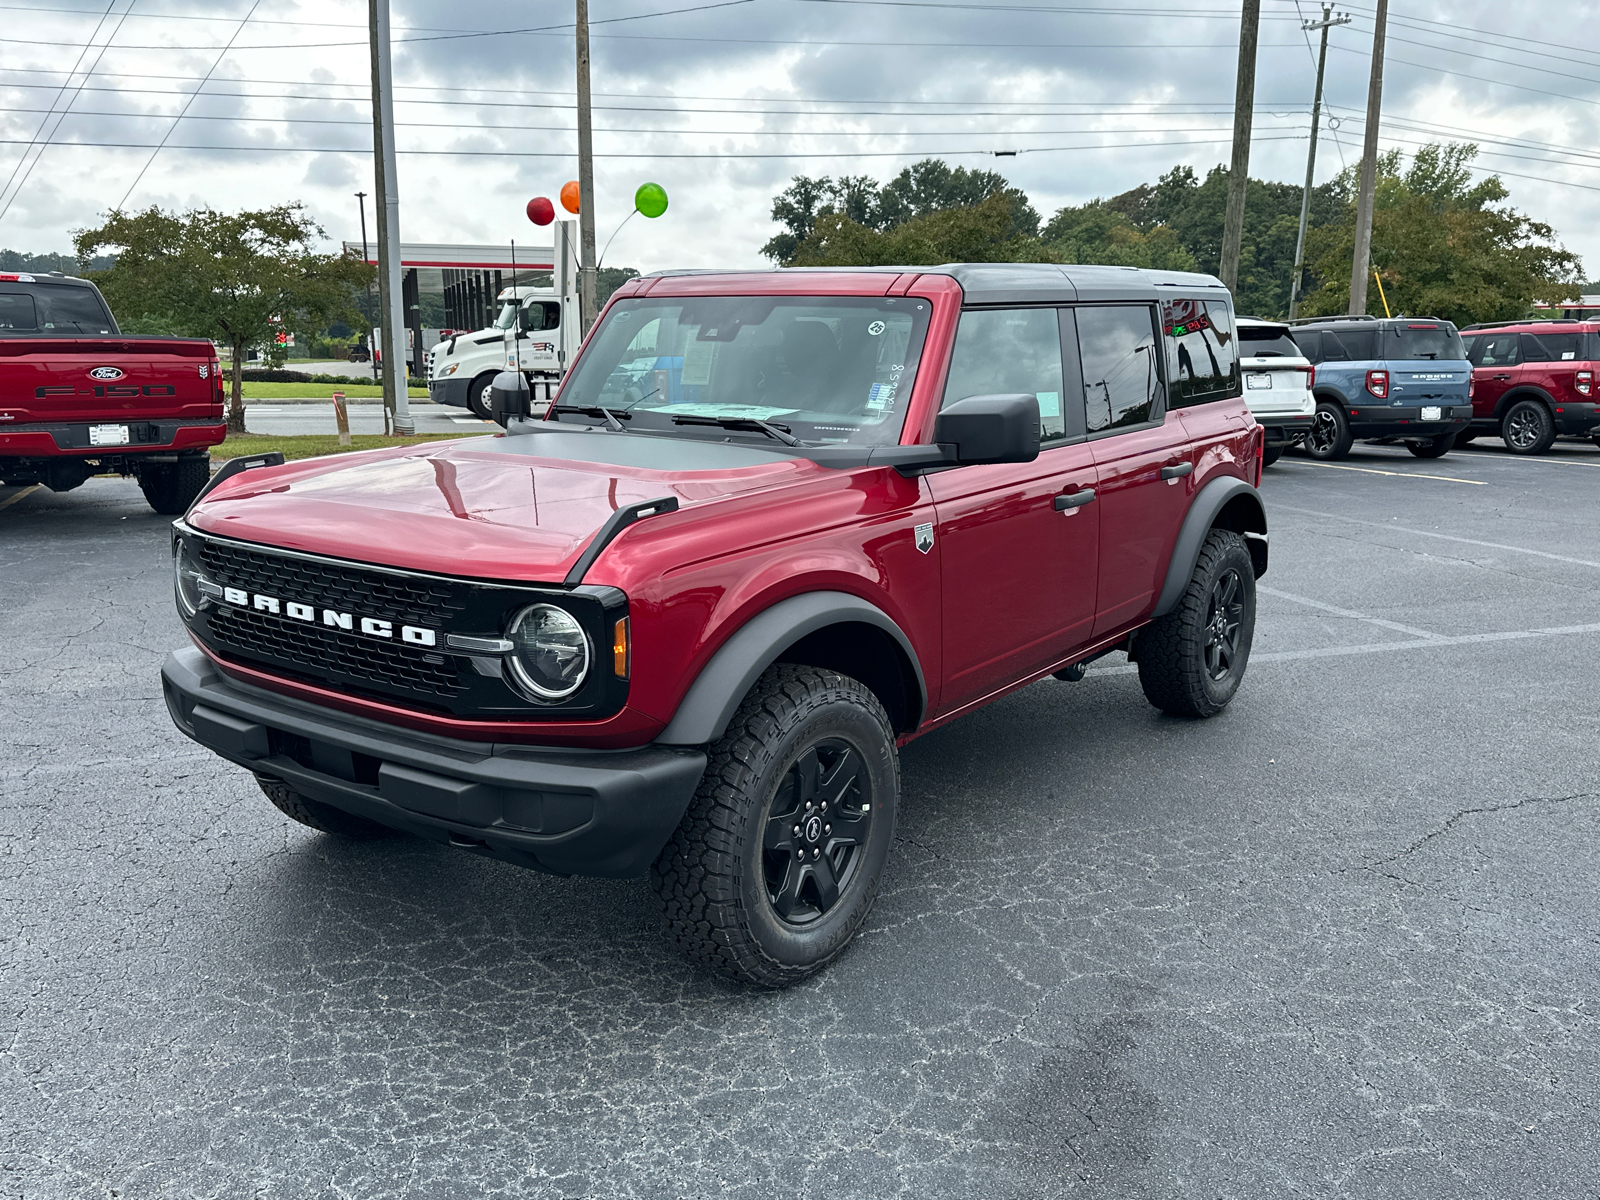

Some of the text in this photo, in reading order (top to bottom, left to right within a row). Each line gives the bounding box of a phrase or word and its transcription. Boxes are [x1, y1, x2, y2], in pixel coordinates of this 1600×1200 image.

[870, 322, 883, 334] 25
[94, 368, 119, 379] Ford
[35, 385, 176, 398] F-150
[224, 587, 436, 646] BRONCO
